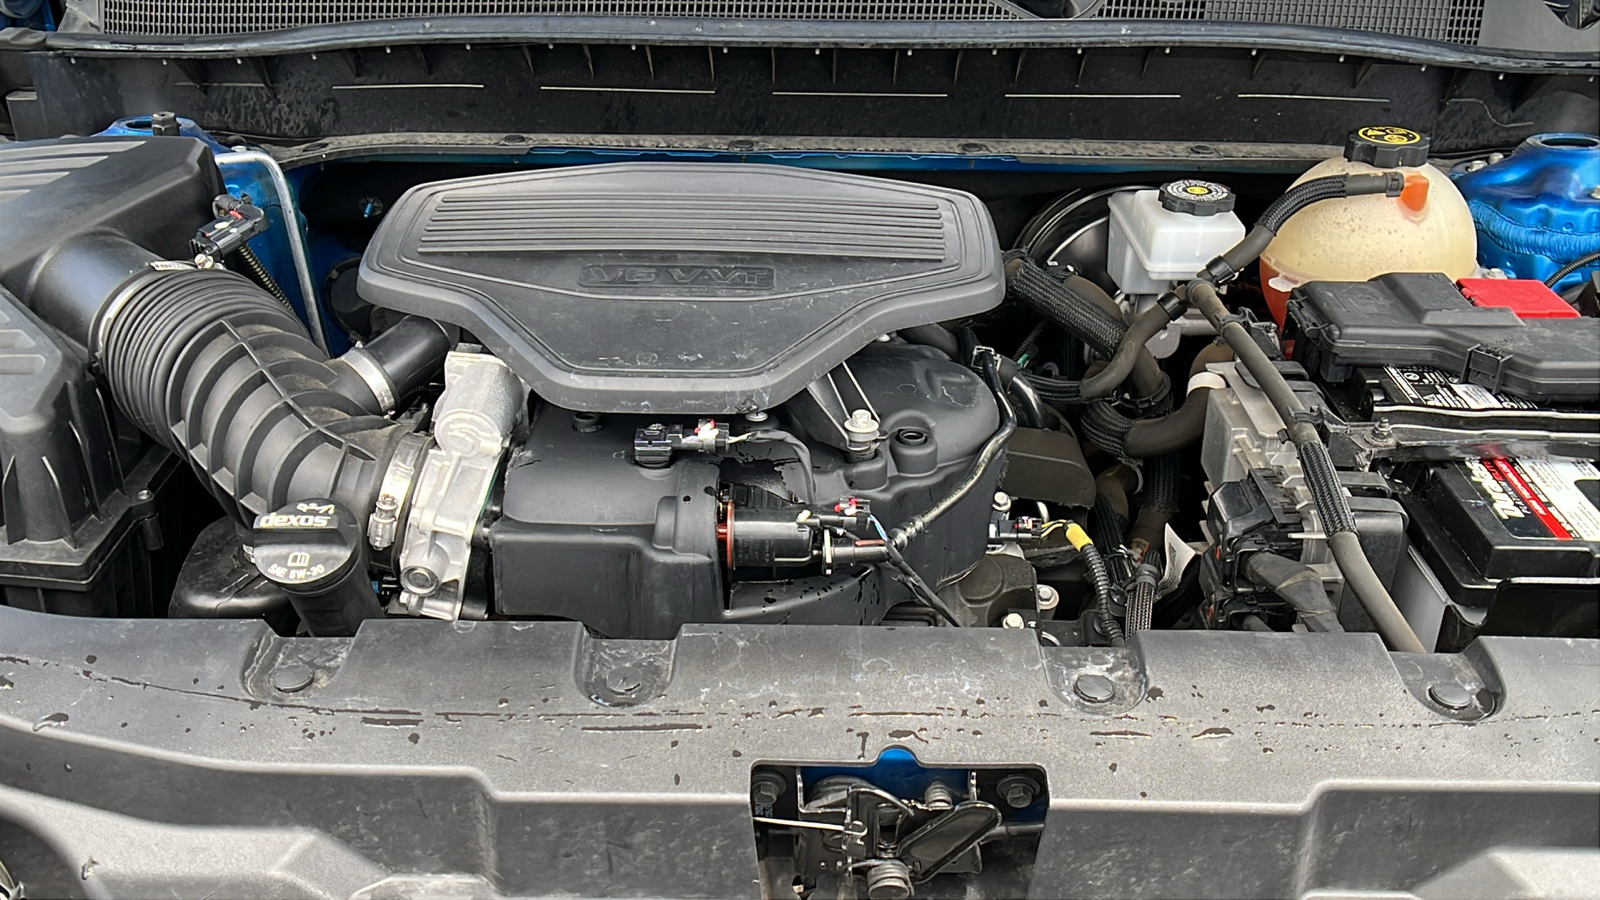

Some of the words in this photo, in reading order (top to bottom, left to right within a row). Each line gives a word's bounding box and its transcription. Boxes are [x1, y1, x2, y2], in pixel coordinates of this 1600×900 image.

[588, 266, 657, 283] V6
[668, 267, 767, 285] VVT
[1500, 481, 1532, 514] PLATINUM
[260, 513, 331, 527] dexos
[268, 564, 288, 578] SAE
